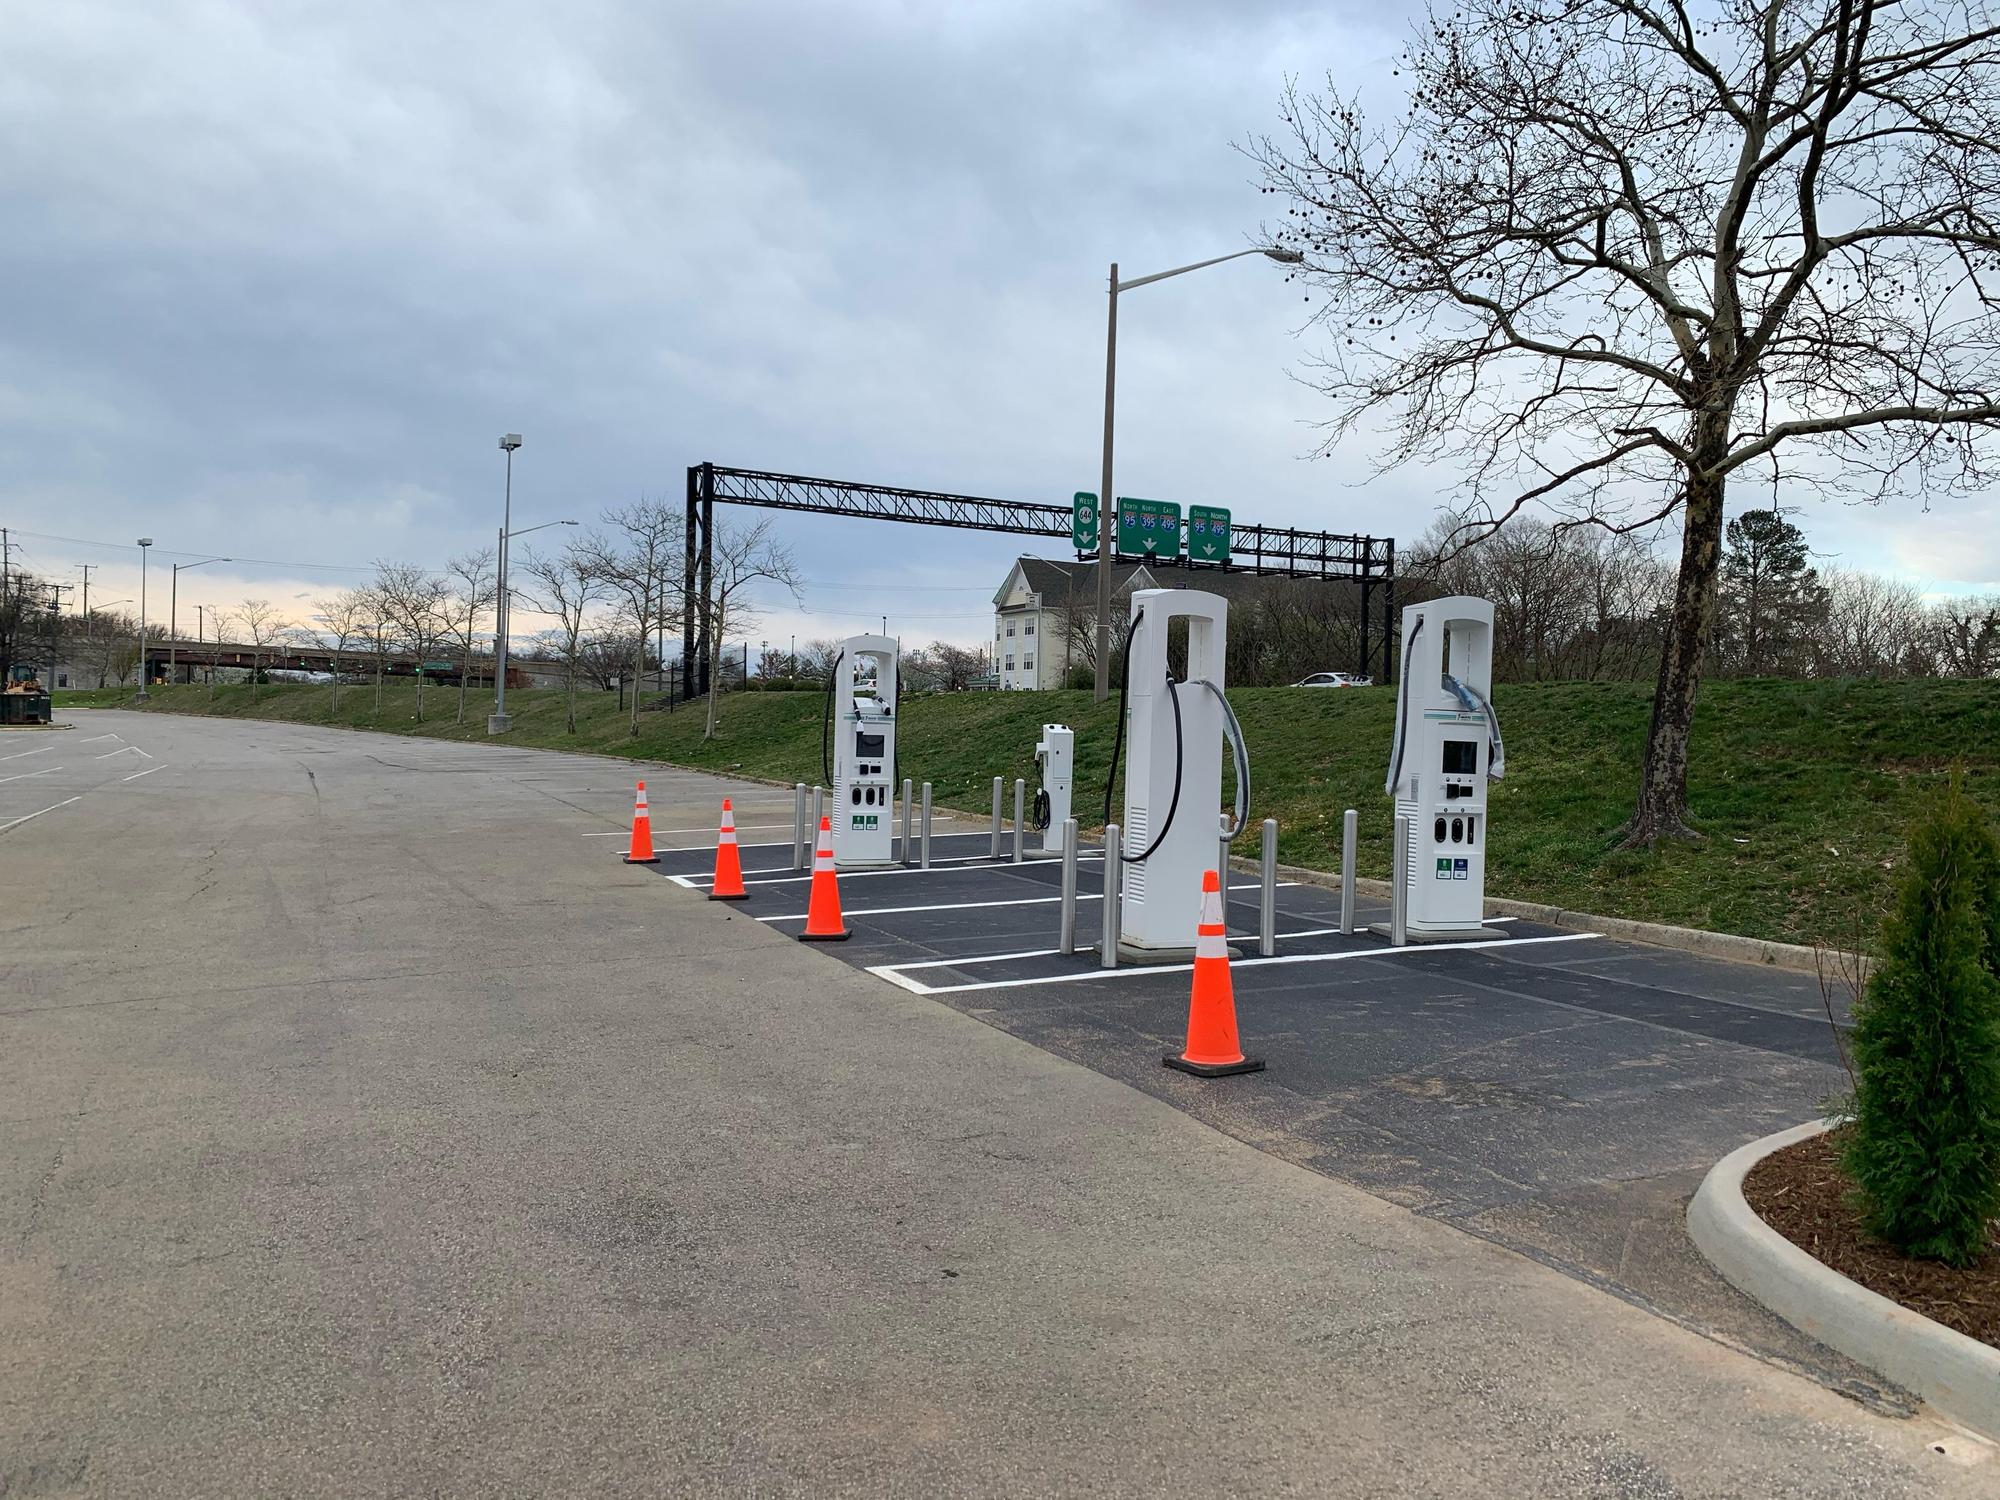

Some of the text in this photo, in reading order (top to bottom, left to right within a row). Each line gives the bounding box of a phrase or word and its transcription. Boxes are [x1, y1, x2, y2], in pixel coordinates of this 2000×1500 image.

[1079, 497, 1093, 505] WEST
[1080, 510, 1092, 520] 644
[1210, 512, 1228, 520] NORTH
[1125, 515, 1175, 529] 95 395 495
[1194, 523, 1225, 534] 95 495
